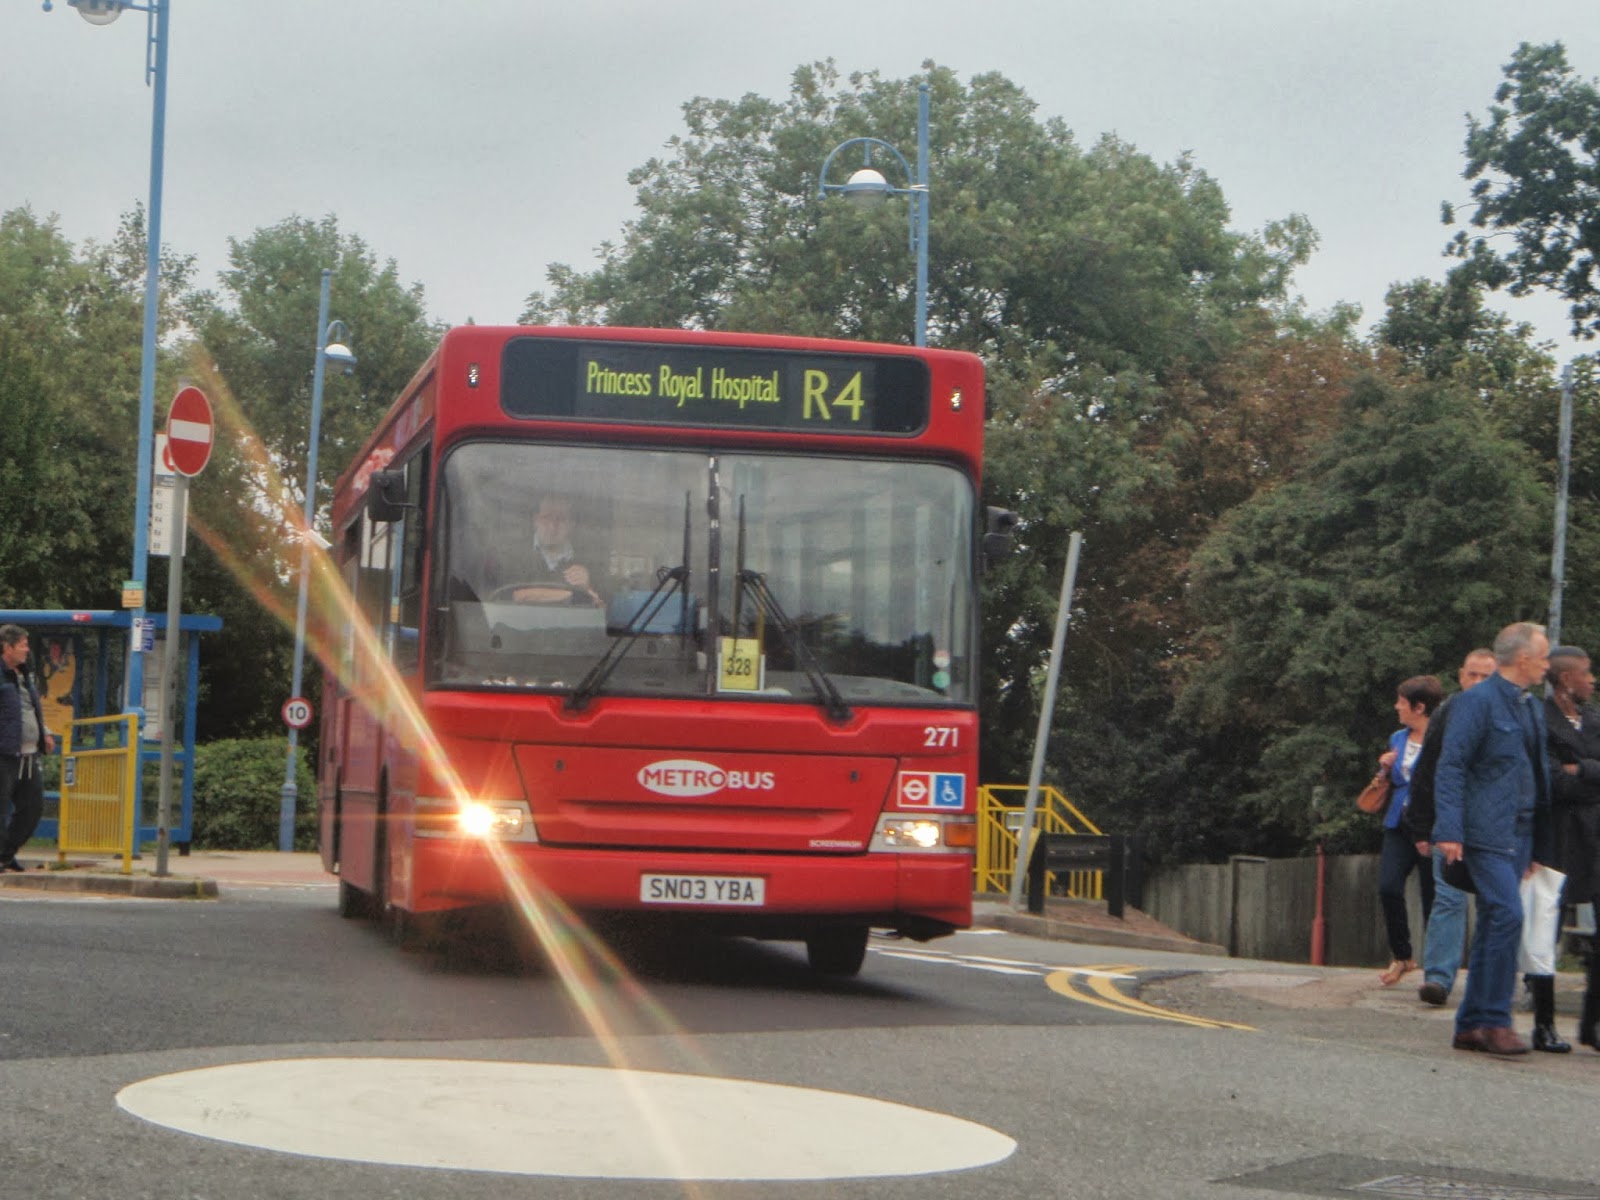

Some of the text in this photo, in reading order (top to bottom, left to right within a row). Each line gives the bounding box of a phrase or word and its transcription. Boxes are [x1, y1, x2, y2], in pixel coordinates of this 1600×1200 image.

[586, 360, 781, 409] Princess Royal Hospital
[802, 369, 865, 421] R4
[725, 656, 752, 676] 328
[289, 706, 307, 720] 10
[923, 726, 959, 748] 271
[641, 766, 775, 791] METROBUS
[649, 877, 755, 902] SN03 YBA
